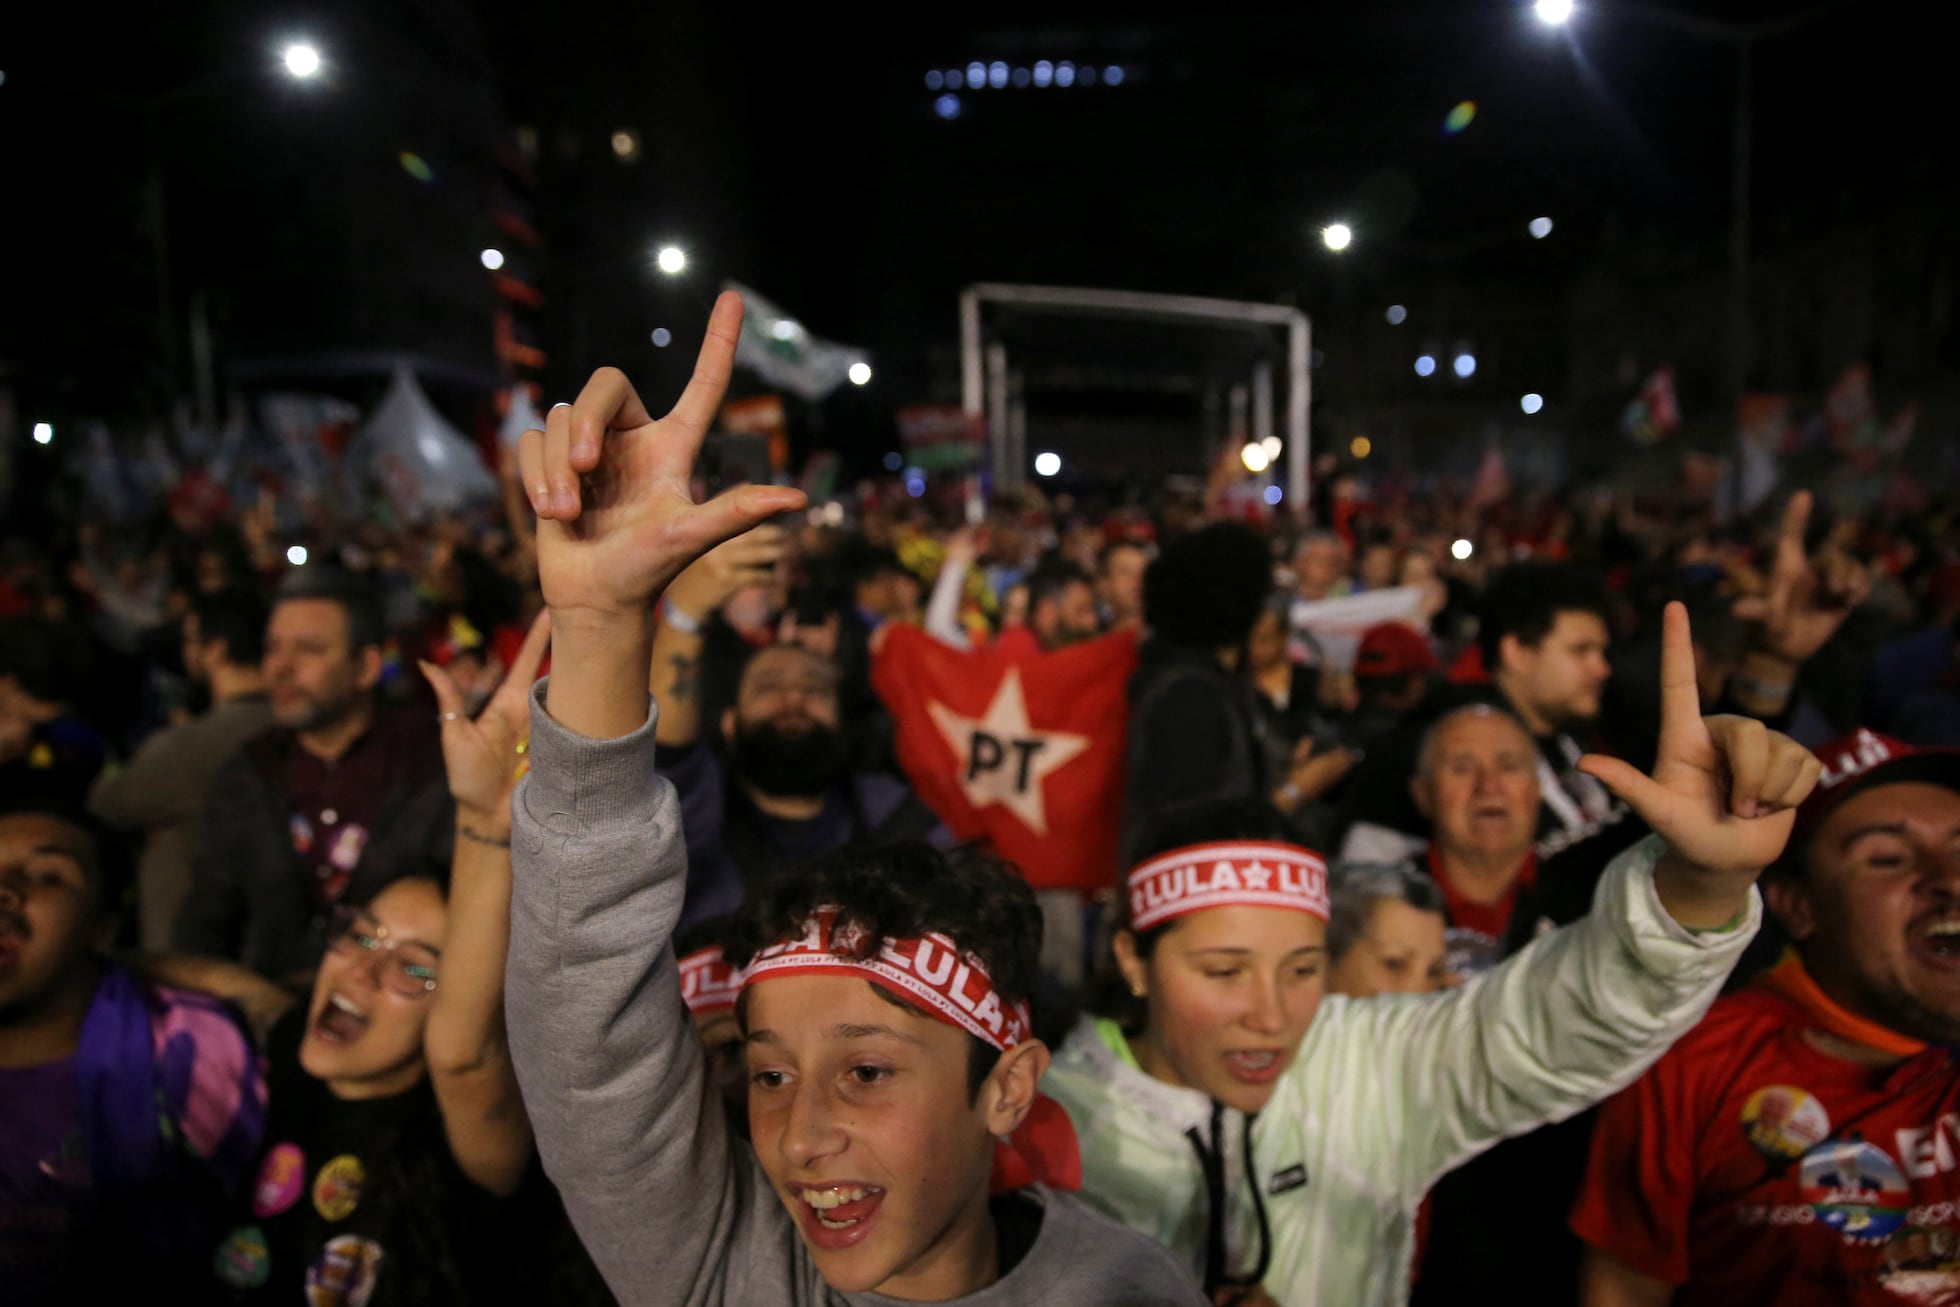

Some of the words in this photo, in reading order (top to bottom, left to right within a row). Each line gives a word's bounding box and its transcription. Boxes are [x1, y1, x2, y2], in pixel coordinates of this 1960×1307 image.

[967, 730, 1046, 793] PT
[1144, 860, 1241, 907] LULA
[880, 936, 1004, 1035] LULA
